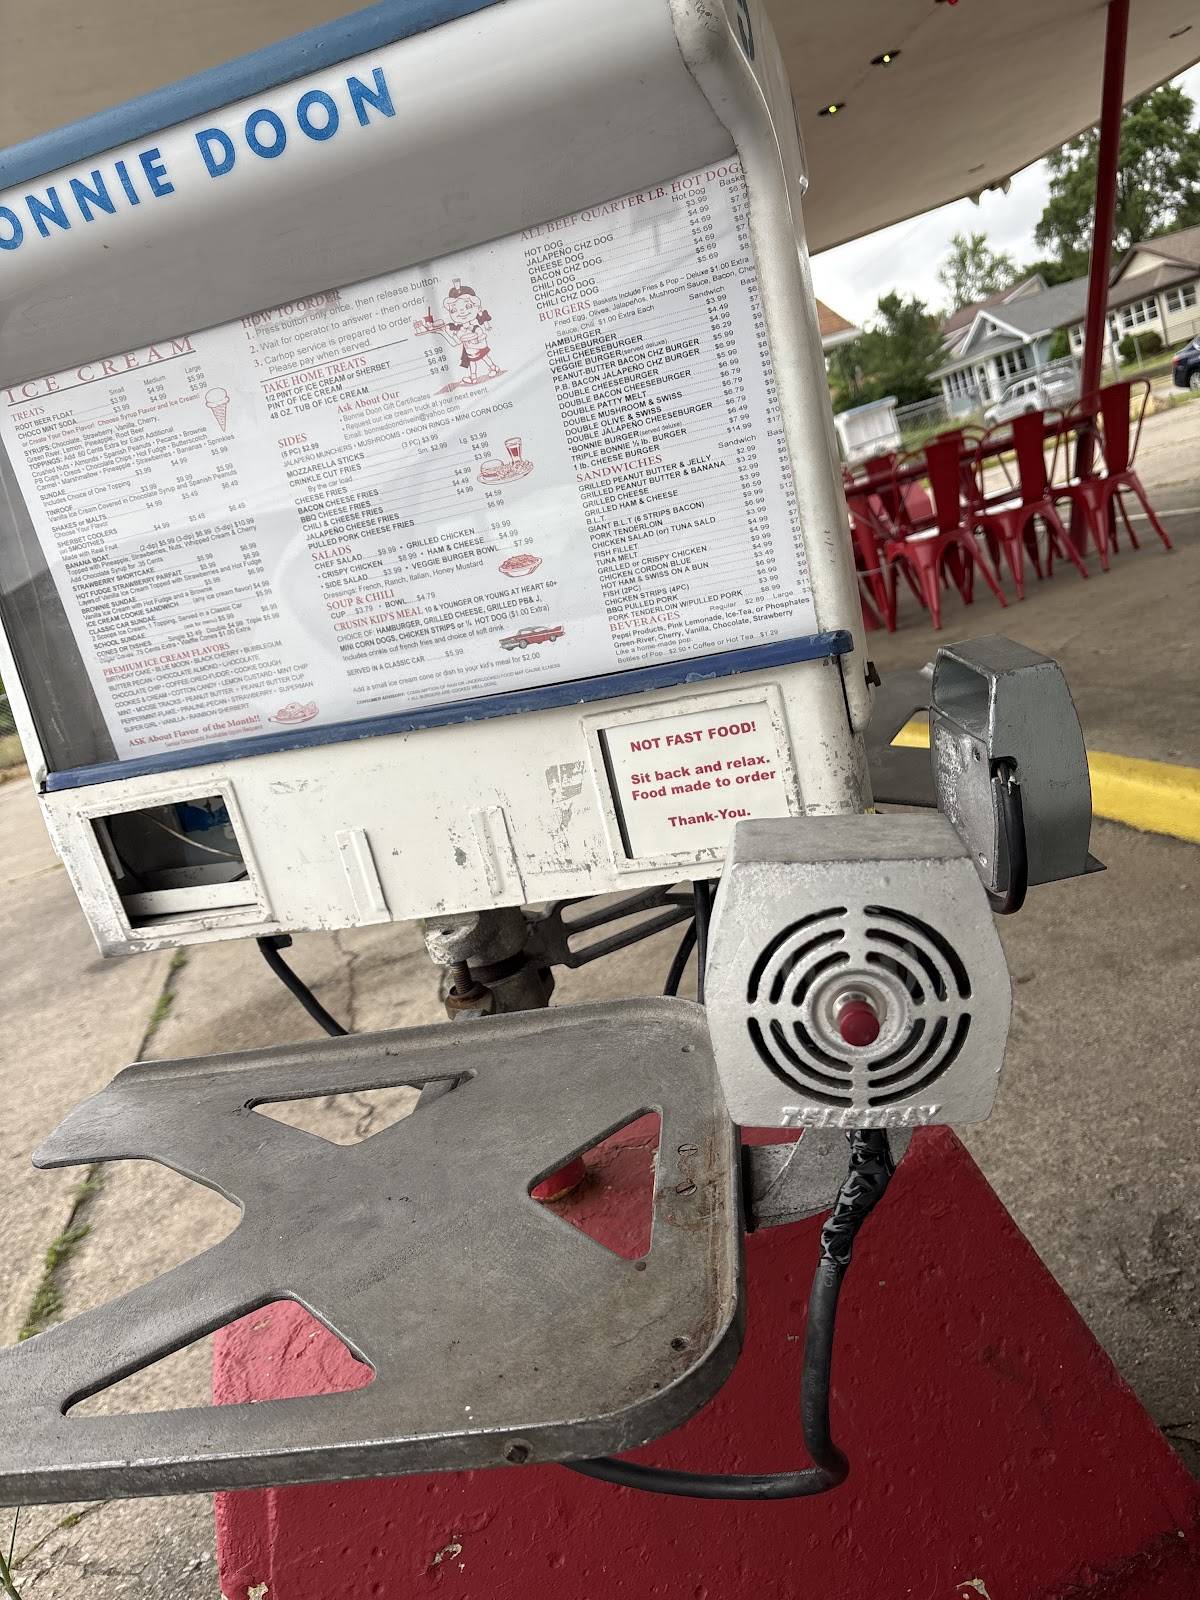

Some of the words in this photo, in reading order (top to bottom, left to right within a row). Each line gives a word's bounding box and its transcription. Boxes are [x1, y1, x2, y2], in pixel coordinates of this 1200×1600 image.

[194, 66, 397, 179] DOON
[672, 193, 687, 202] Hot
[688, 187, 705, 197] Dog
[519, 225, 544, 241] ALL
[546, 214, 577, 233] BEEF
[581, 194, 645, 221] QUARTER
[648, 188, 667, 200] LB.
[672, 175, 700, 193] HOT
[524, 246, 541, 257] HOT
[544, 240, 563, 251] DOG
[527, 247, 572, 266] JALAPEÑO
[574, 241, 592, 251] CHZ
[594, 234, 613, 246] DOG
[688, 205, 709, 216] $4.99
[528, 259, 563, 275] CHEESE
[565, 253, 584, 264] DOG
[530, 269, 561, 284] BACON
[563, 263, 581, 274] CHZ
[582, 257, 602, 268] DOG
[533, 280, 554, 292] CHILI
[556, 274, 575, 285] DOG
[694, 233, 715, 244] $4.69
[242, 310, 271, 328] HOW
[277, 303, 294, 318] TO
[296, 288, 342, 311] ORDER
[246, 332, 254, 340] 1.
[255, 322, 280, 337] Press
[279, 313, 308, 329] button
[307, 307, 328, 321] only
[328, 302, 353, 315] once,
[355, 296, 374, 308] then
[376, 286, 408, 302] release
[539, 300, 591, 321] BURGERS
[545, 329, 602, 349] HAMBURGER
[706, 294, 727, 305] $3.99
[547, 333, 617, 357] CHEESEBURGER
[708, 303, 728, 313] $4.49
[269, 362, 298, 374] Please
[299, 356, 314, 367] pay
[316, 349, 340, 360] when
[549, 355, 570, 365] CHILI
[572, 335, 643, 359] CHEESEBURGER
[7, 377, 59, 403] ICE
[77, 334, 192, 384] CREAM
[262, 379, 290, 393] TAKE
[291, 369, 324, 386] HOME
[325, 356, 366, 375] TREATS
[267, 400, 284, 410] PINT
[287, 396, 297, 405] OF
[299, 393, 313, 401] ICE
[314, 384, 342, 397] CREAM
[338, 403, 353, 413] Ask
[355, 396, 380, 409] About
[382, 392, 399, 401] Our
[561, 404, 595, 418] DOUBLE
[597, 397, 622, 409] PATTY
[625, 391, 646, 402] MELT
[720, 368, 741, 377] $6.79
[11, 406, 45, 422] TREATS
[15, 421, 33, 431] ROOT
[34, 417, 52, 426] BEER
[52, 410, 73, 421] FLOAT
[18, 429, 41, 439] CHOCO
[42, 424, 57, 432] MINT
[58, 419, 78, 428] SODA
[278, 433, 307, 448] SIDES
[591, 453, 623, 466] CHEESE
[625, 444, 660, 458] BURGER
[727, 422, 752, 433] $14.99
[287, 460, 336, 478] MOZZARELLA
[337, 453, 365, 465] STICKS
[577, 454, 662, 482] SANDWICHES
[295, 492, 325, 505] CHEESE
[326, 487, 348, 497] FRIES
[583, 496, 616, 508] GRILLED
[617, 487, 649, 500] CHEESE
[738, 462, 758, 472] $2.99
[585, 504, 618, 517] GRILLED
[619, 500, 637, 508] HAM
[646, 490, 678, 502] CHEESE
[740, 472, 760, 481] $3.99
[52, 522, 77, 534] SHAKES
[306, 526, 344, 541] JALAPEÑO
[346, 519, 376, 531] CHEESE
[377, 513, 399, 524] FRIES
[406, 536, 439, 549] GRILLED
[441, 528, 475, 541] CHICKEN
[491, 520, 511, 530] $9.99
[312, 545, 351, 561] SALADS
[411, 558, 440, 569] VEGGIE
[442, 550, 475, 563] BURGER
[476, 546, 500, 555] BOWL
[596, 557, 616, 566] TUNA
[618, 552, 637, 561] MELT
[749, 524, 769, 533] $4.99
[65, 559, 91, 571] BANANA
[92, 554, 110, 563] BOAT
[81, 603, 110, 614] BROWNIE
[111, 597, 137, 608] SUNDAE
[327, 598, 353, 611] SOUP
[356, 596, 364, 604] &
[365, 589, 394, 602] CHILI
[331, 611, 346, 619] CUP
[385, 599, 407, 608] BOWL
[334, 617, 368, 631] CRUSIN
[369, 612, 395, 624] KID'S
[396, 607, 423, 619] MEAL
[610, 611, 680, 631] BEVERAGES
[612, 631, 631, 640] Pepsi
[632, 626, 666, 636] Products,
[684, 614, 724, 626] Lemonade,
[725, 609, 754, 618] Ice-Tea,
[765, 598, 809, 610] Phosphates
[103, 662, 143, 676] PREMIUM
[144, 658, 159, 667] ICE
[159, 651, 190, 663] CREAM
[191, 642, 230, 656] FLAVORS
[130, 737, 146, 746] ASK
[148, 733, 172, 743] About
[173, 729, 199, 738] Flavor
[202, 724, 211, 732] of
[630, 737, 661, 752] NOT
[665, 730, 703, 747] FAST
[707, 721, 757, 739] FOOD!
[630, 772, 652, 785] Sit
[654, 766, 691, 781] back
[695, 760, 722, 775] and
[726, 755, 770, 770] relax.
[631, 786, 667, 801] Food
[671, 780, 711, 795] made
[715, 777, 731, 788] to
[735, 769, 776, 784] order
[667, 808, 752, 827] Thank-You.
[780, 1104, 942, 1128] TELETRAY
